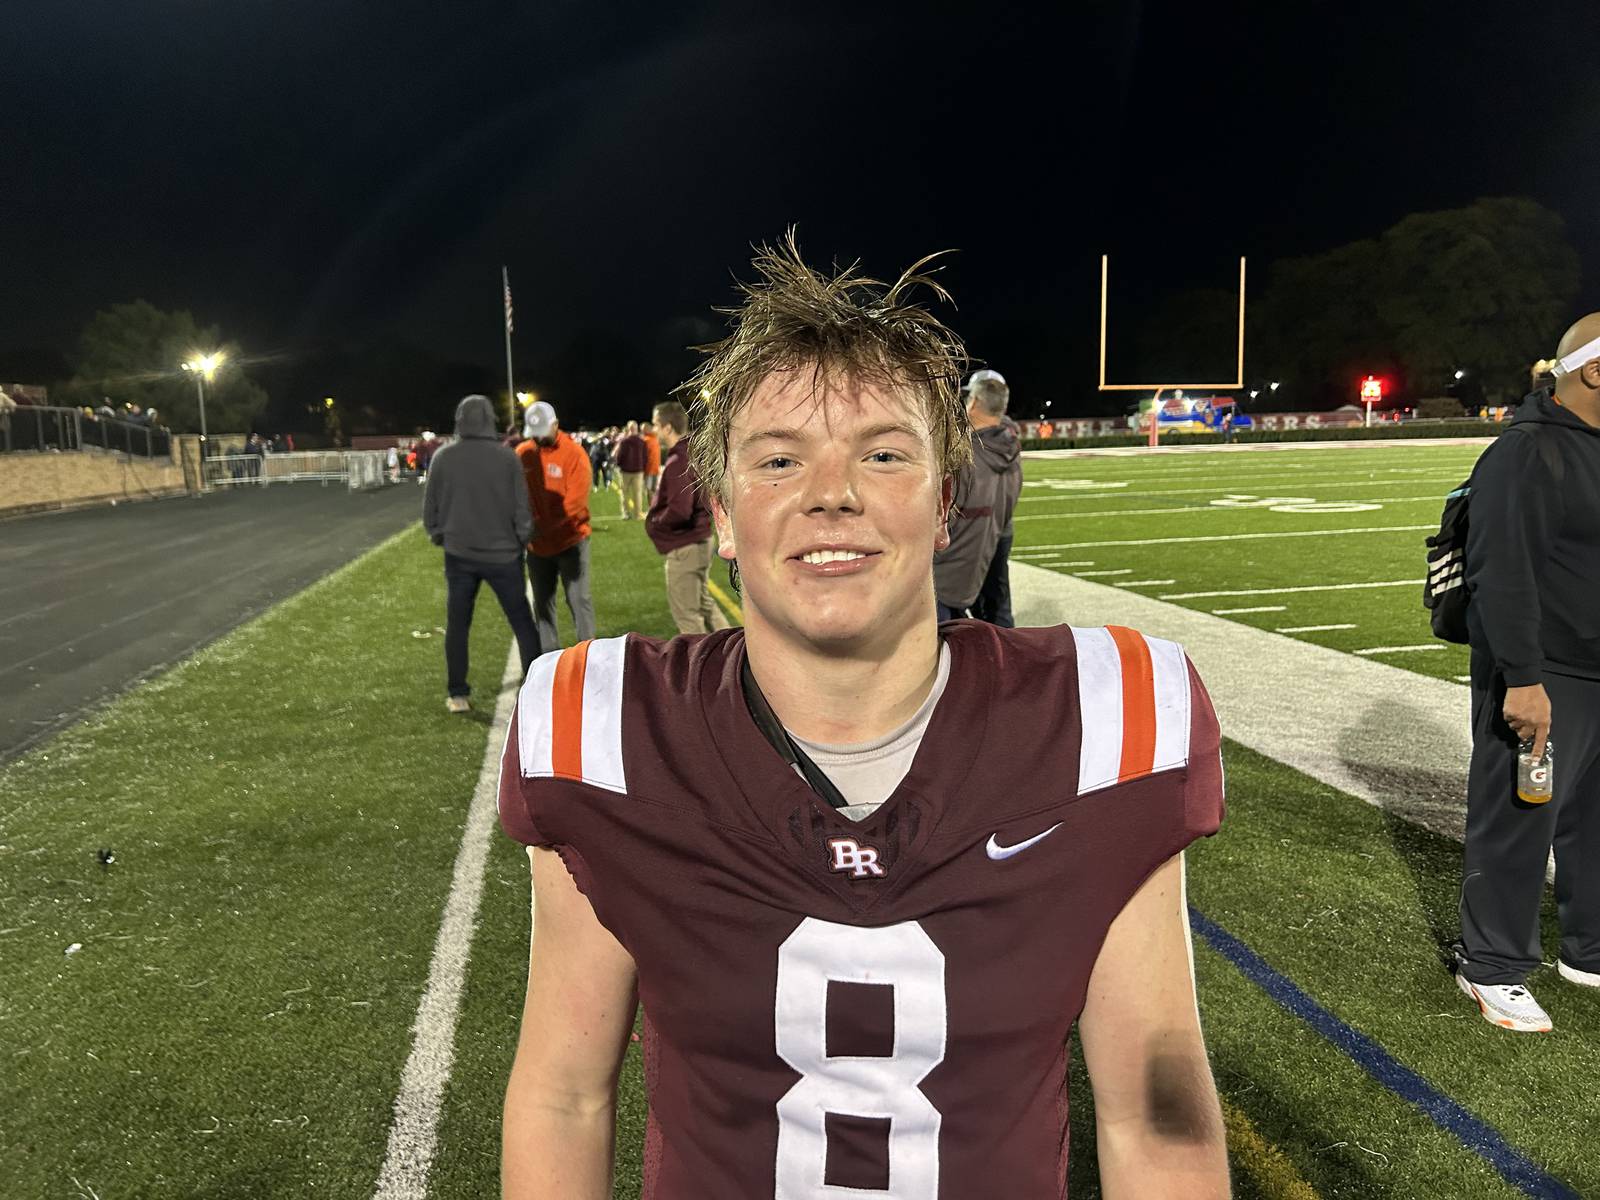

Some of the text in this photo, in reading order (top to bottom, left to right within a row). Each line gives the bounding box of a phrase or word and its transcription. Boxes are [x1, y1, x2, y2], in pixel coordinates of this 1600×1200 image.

[1055, 419, 1115, 438] THE
[1530, 767, 1547, 783] G
[830, 840, 884, 877] BR
[775, 916, 947, 1200] 8
